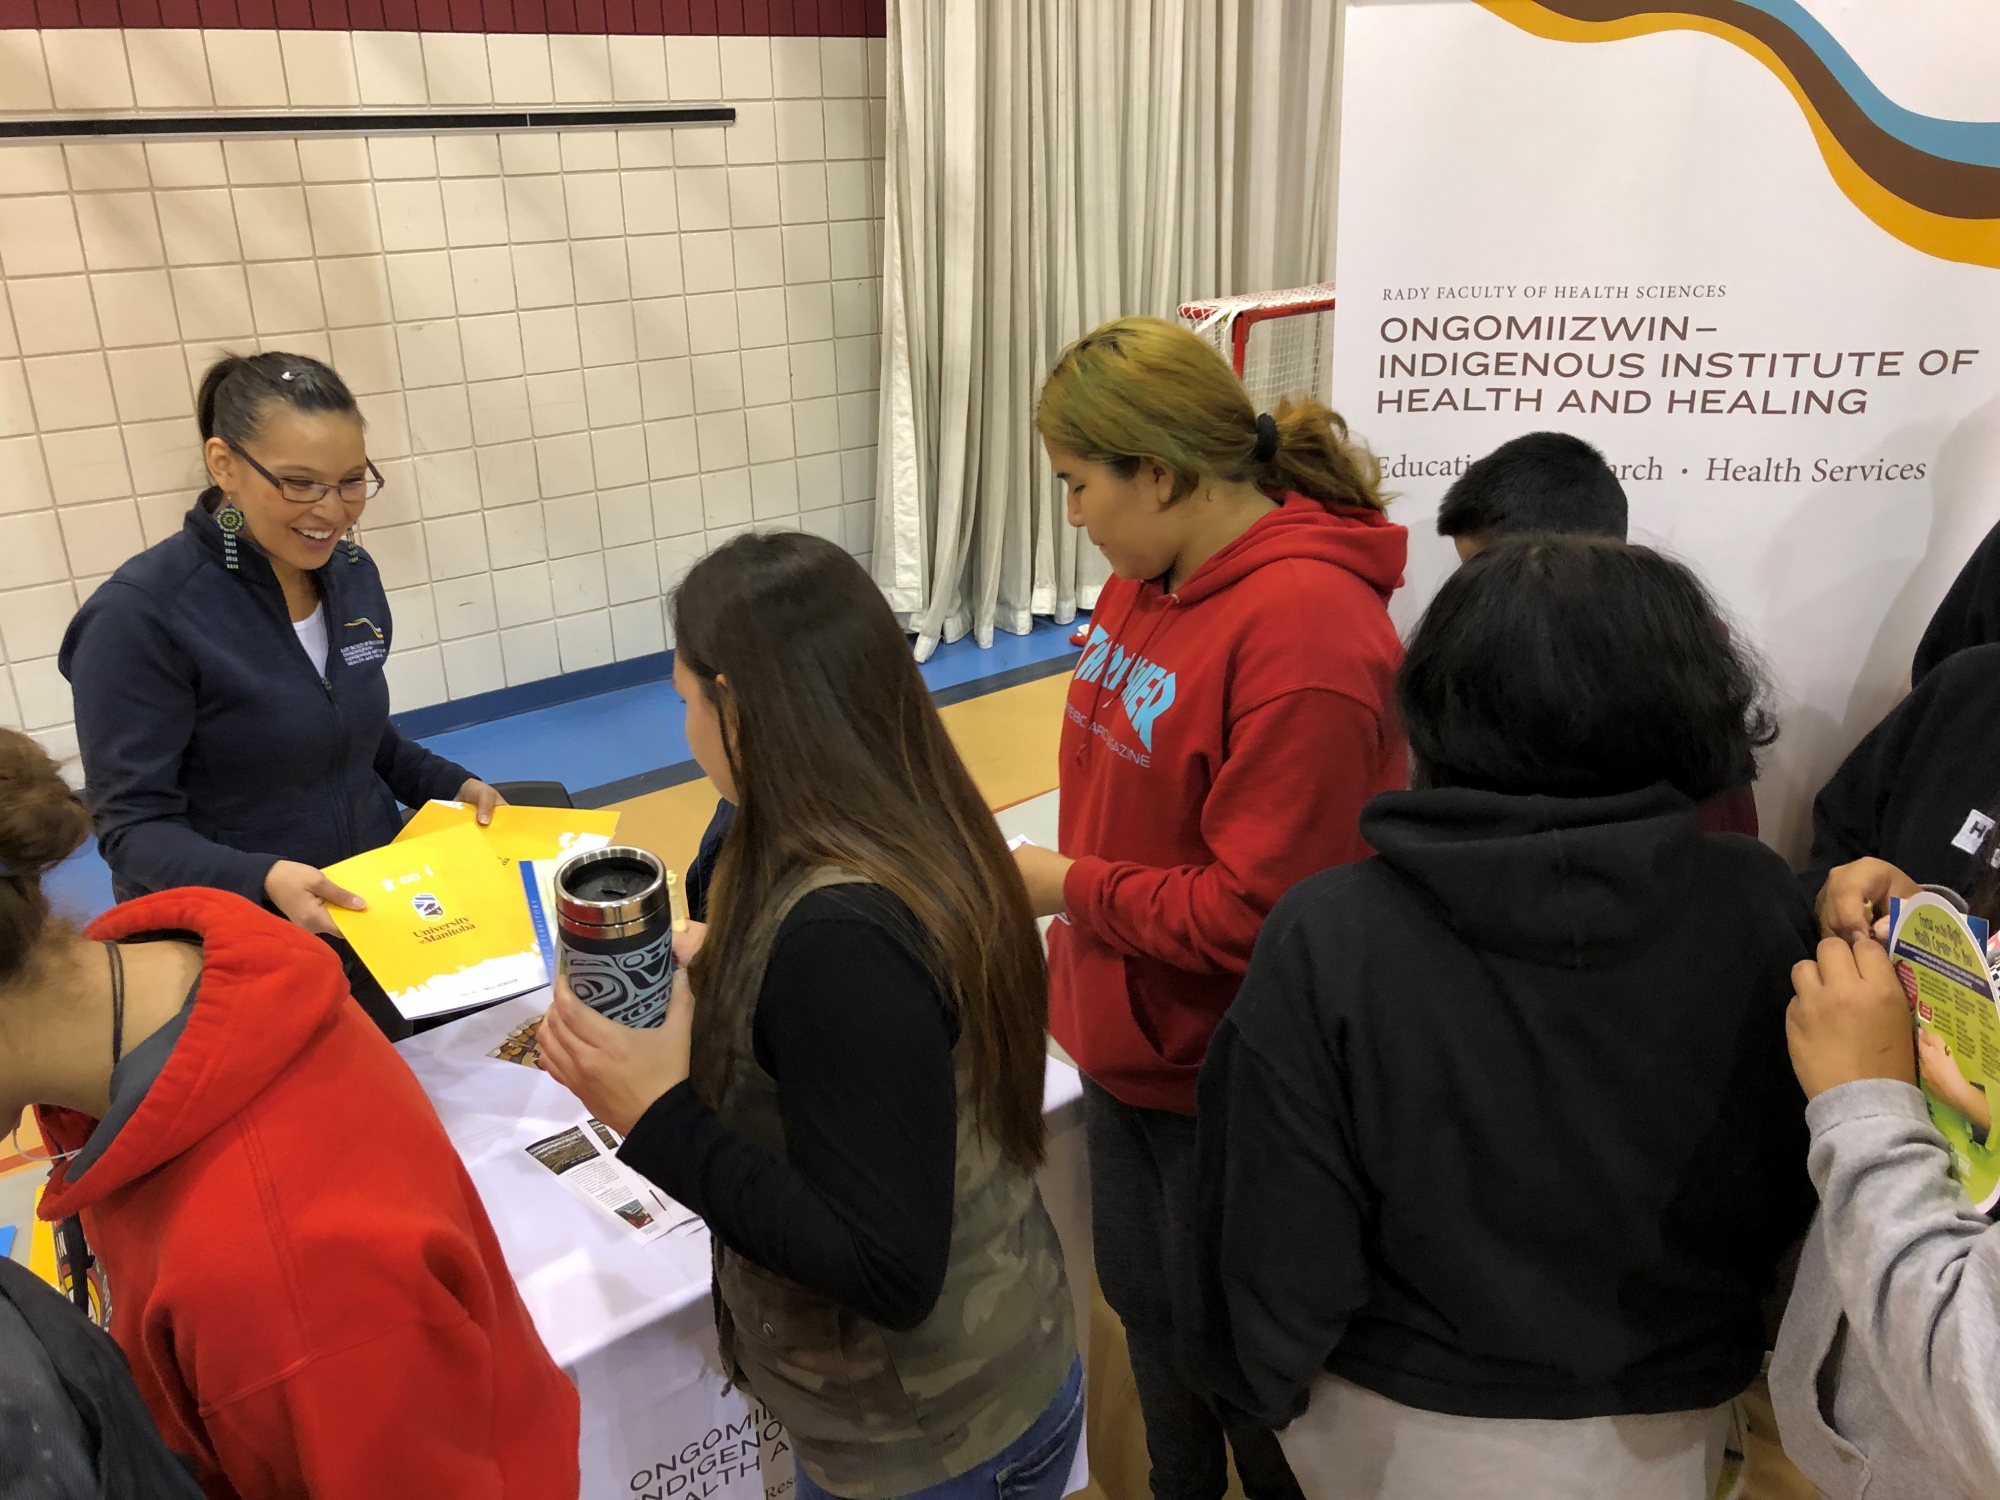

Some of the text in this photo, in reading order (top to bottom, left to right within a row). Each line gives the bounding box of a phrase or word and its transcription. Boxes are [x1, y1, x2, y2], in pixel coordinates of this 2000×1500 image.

[1382, 284, 1727, 301] RADY FACULTY OF HEALTH SCIENCES
[1379, 348, 1980, 379] INDIGENOUS INSTITUTE OF
[1377, 387, 1868, 415] HEALTH AND HEALING
[1378, 453, 1471, 479] Educati
[1704, 456, 1802, 483] Health
[1811, 457, 1927, 483] Services
[412, 916, 470, 938] University
[423, 923, 477, 943] Manitoba
[629, 1407, 775, 1491] ONGOMII
[634, 1420, 783, 1500] NDIGENO
[770, 1440, 790, 1463] A
